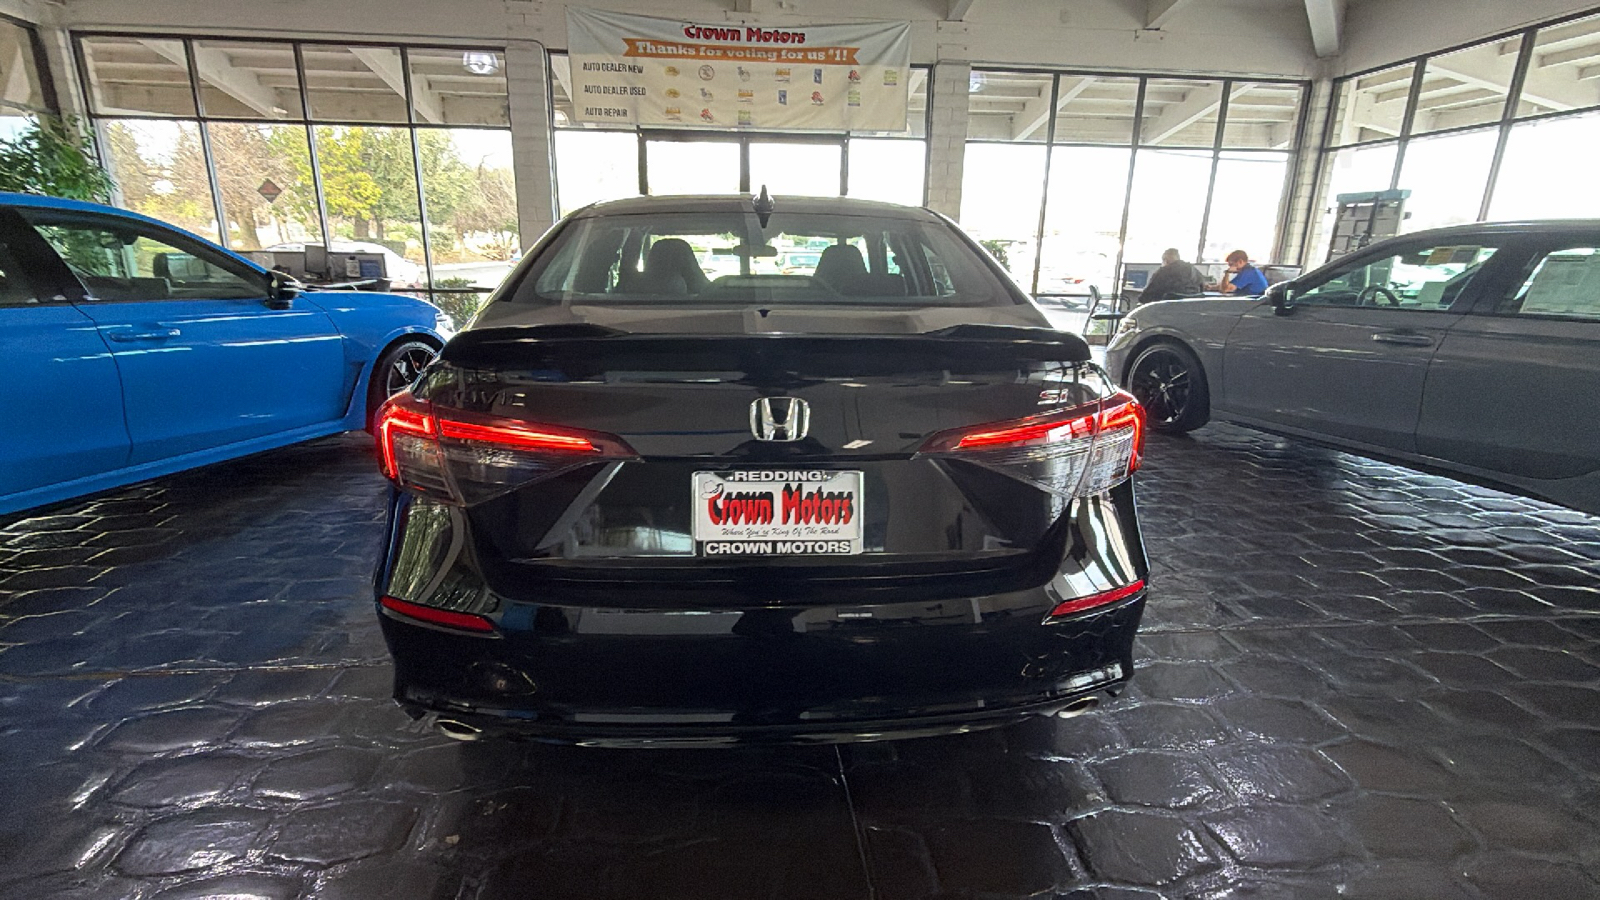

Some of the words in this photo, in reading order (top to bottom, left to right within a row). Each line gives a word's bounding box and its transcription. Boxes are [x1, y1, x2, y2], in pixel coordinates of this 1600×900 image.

[684, 25, 741, 41] Crown
[746, 27, 806, 44] Motors
[636, 41, 696, 56] Thanks
[699, 46, 722, 56] for
[726, 48, 778, 61] voting
[781, 49, 803, 60] for
[807, 51, 826, 60] us
[583, 62, 600, 71] AUTO
[601, 62, 627, 73] DEALER
[628, 64, 644, 74] NEW
[584, 84, 602, 94] AUTO
[603, 85, 628, 96] DEALER
[629, 86, 646, 96] USED
[585, 107, 602, 116] AUTO
[604, 108, 628, 117] REPAIR
[734, 471, 823, 481] REDDING
[708, 483, 774, 525] Crown
[782, 483, 854, 525] Motors
[721, 527, 744, 536] Where
[771, 527, 789, 537] King
[791, 527, 802, 537] Of
[804, 526, 818, 535] The
[820, 526, 841, 535] Road
[706, 542, 773, 554] CROWN
[776, 541, 851, 553] MOTORS
